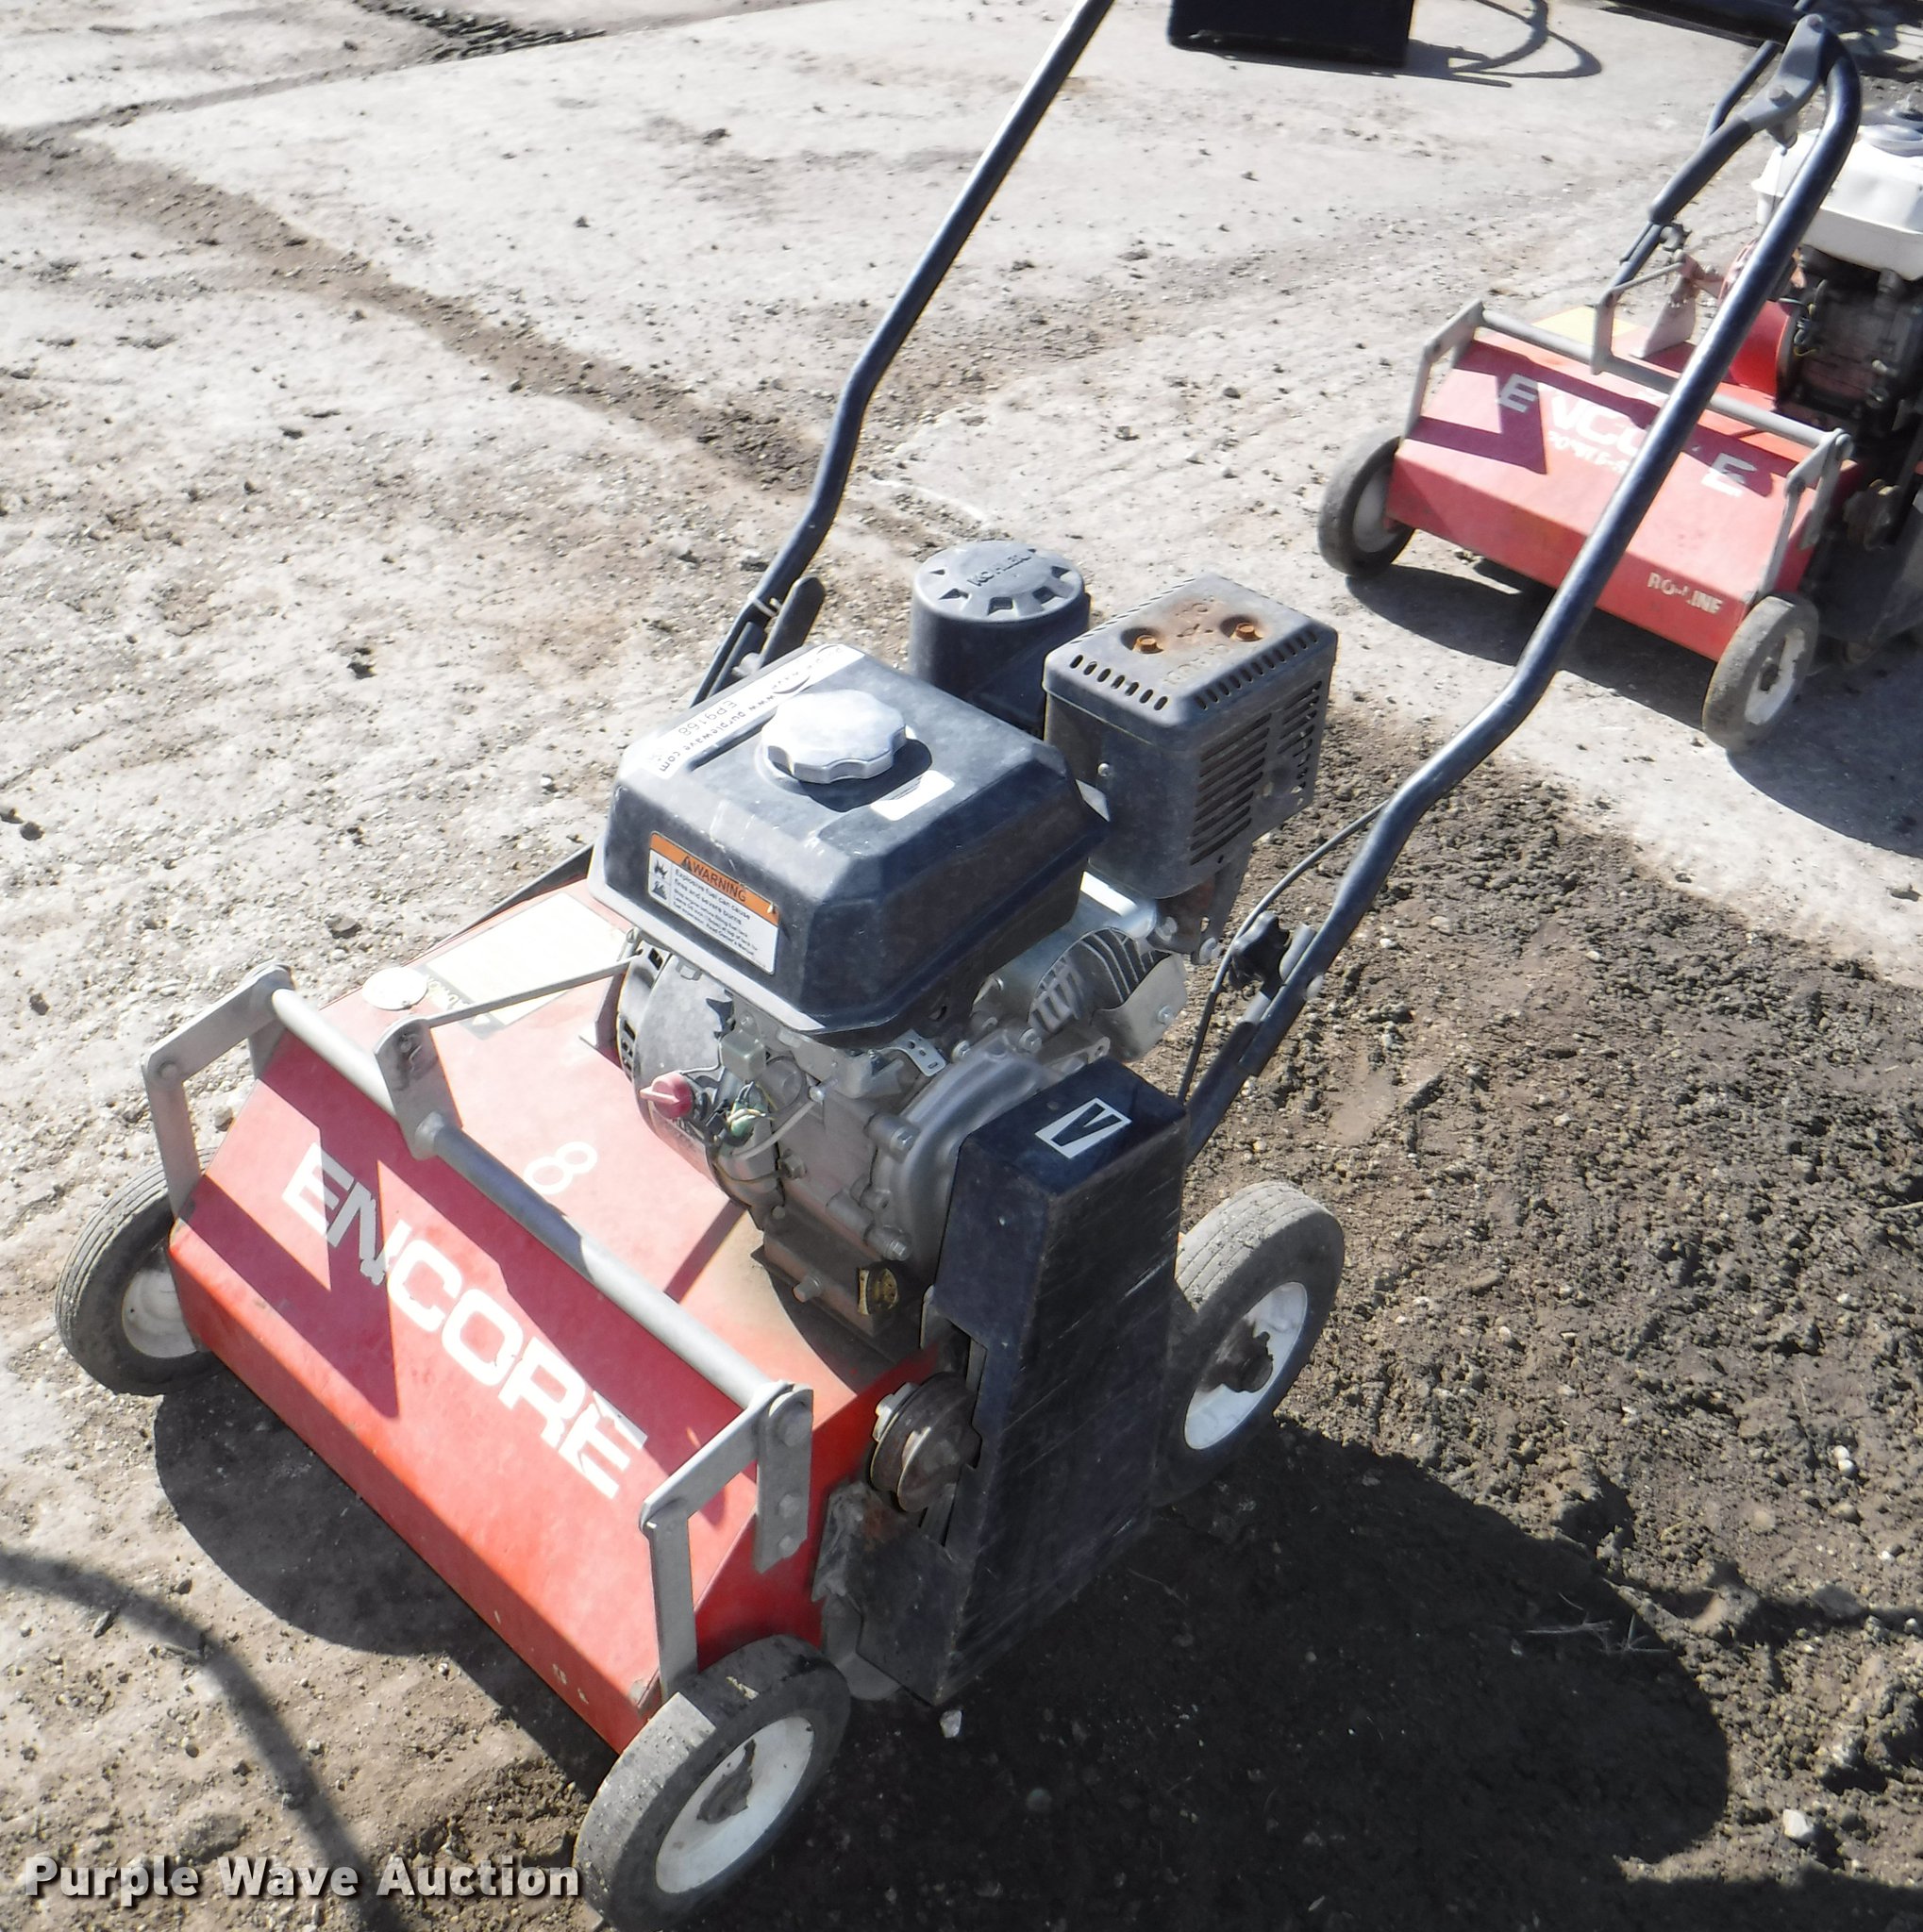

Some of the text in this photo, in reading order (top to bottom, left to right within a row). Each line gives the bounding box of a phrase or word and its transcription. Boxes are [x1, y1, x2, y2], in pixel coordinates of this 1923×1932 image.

[1496, 375, 1758, 498] ENCE
[693, 863, 746, 903] WARNING
[523, 1141, 598, 1196] 8
[282, 1141, 648, 1499] ENCORE
